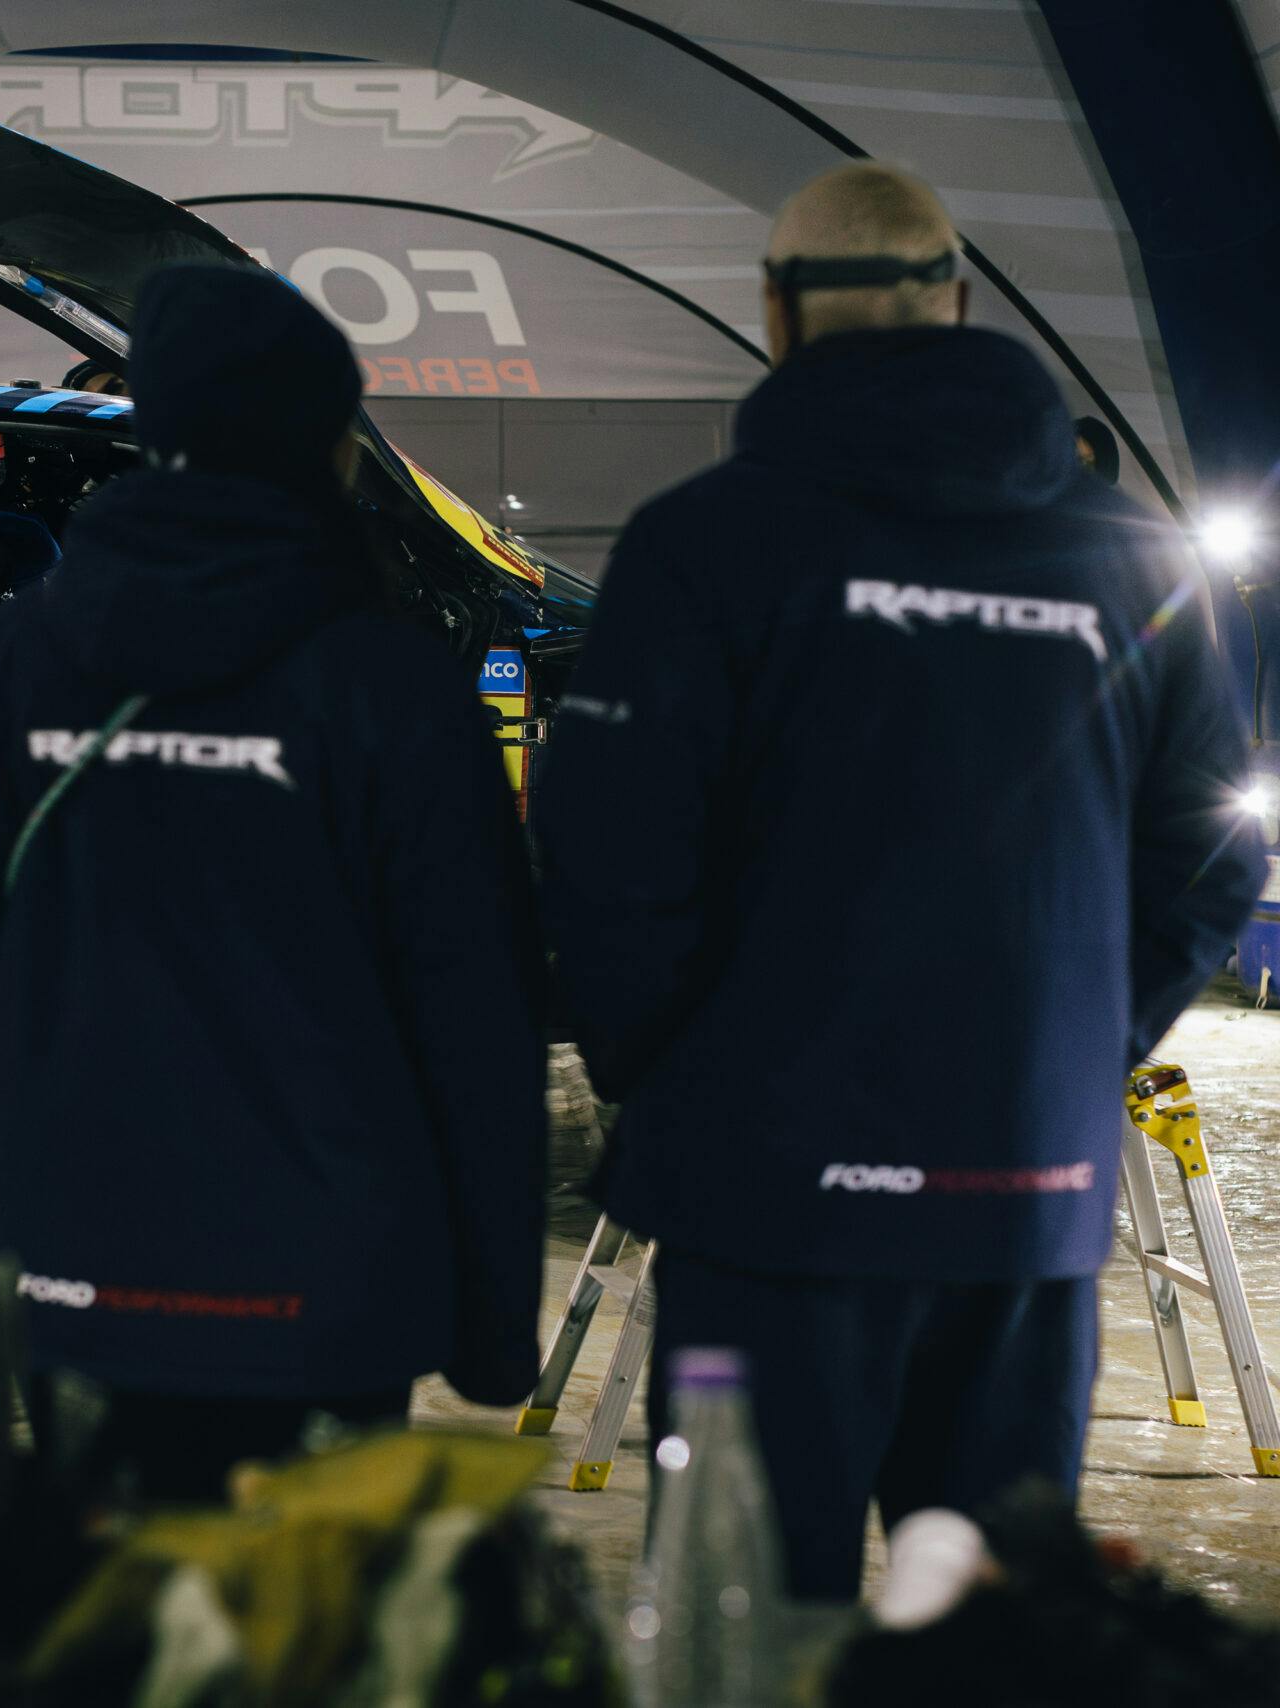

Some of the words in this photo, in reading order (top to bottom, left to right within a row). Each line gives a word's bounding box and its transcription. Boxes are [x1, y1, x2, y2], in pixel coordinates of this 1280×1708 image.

[846, 579, 1108, 661] RAPTOR
[821, 1163, 926, 1194] FORD
[17, 1272, 97, 1309] FORD
